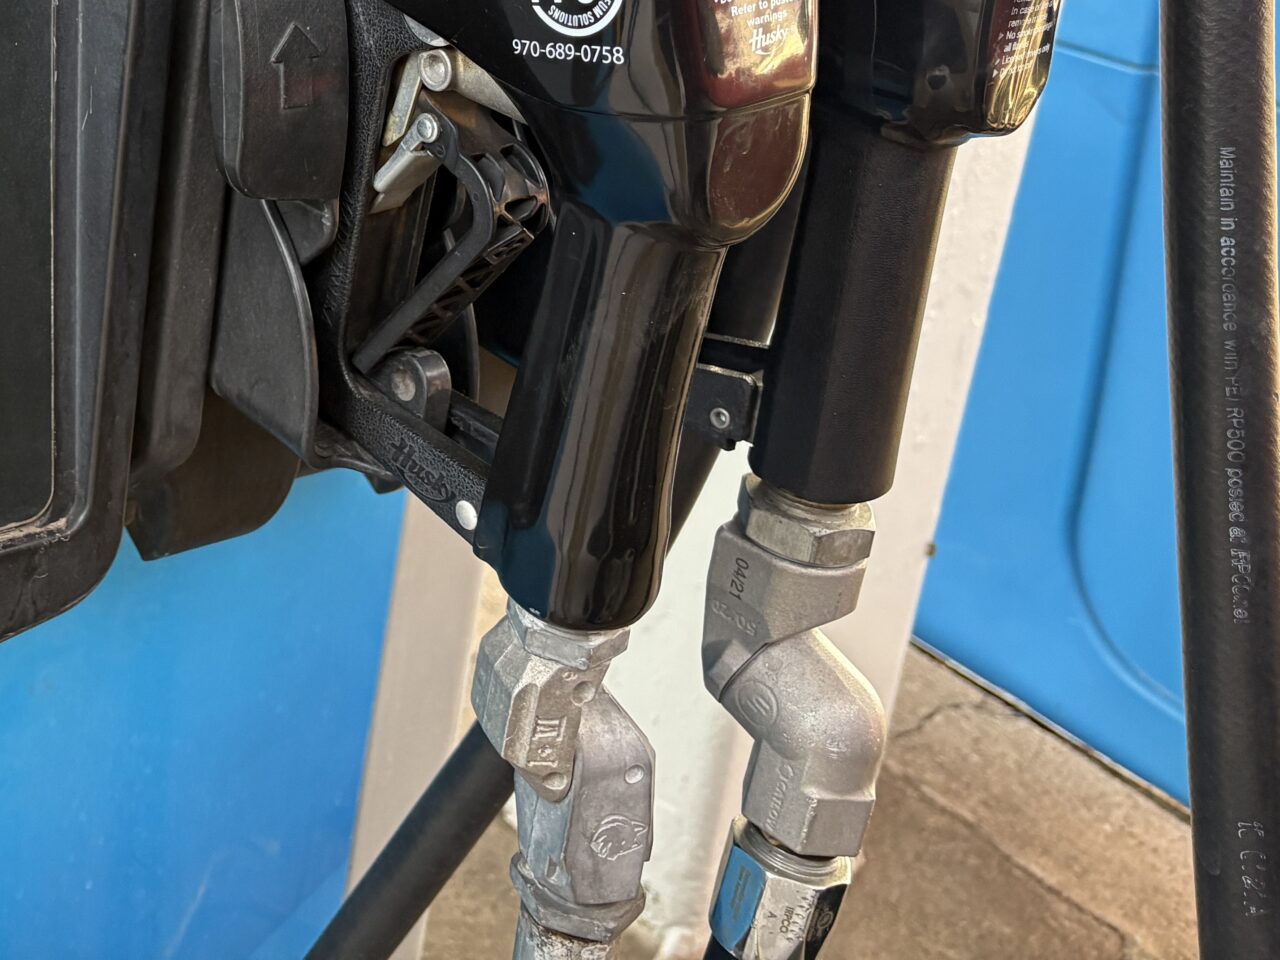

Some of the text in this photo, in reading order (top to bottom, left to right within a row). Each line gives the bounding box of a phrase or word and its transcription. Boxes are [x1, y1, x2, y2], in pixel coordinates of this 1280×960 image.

[548, 5, 595, 26] SOLUTIONS
[731, 3, 756, 16] Refer
[759, 0, 768, 9] to
[747, 10, 787, 27] warnings
[512, 39, 625, 64] 970-689-0758
[749, 25, 787, 52] Husky
[1219, 147, 1238, 211] Maintain
[1220, 218, 1238, 231] in
[1220, 236, 1239, 331] accordance
[1226, 407, 1245, 463] RP500
[729, 557, 749, 600] 04/21
